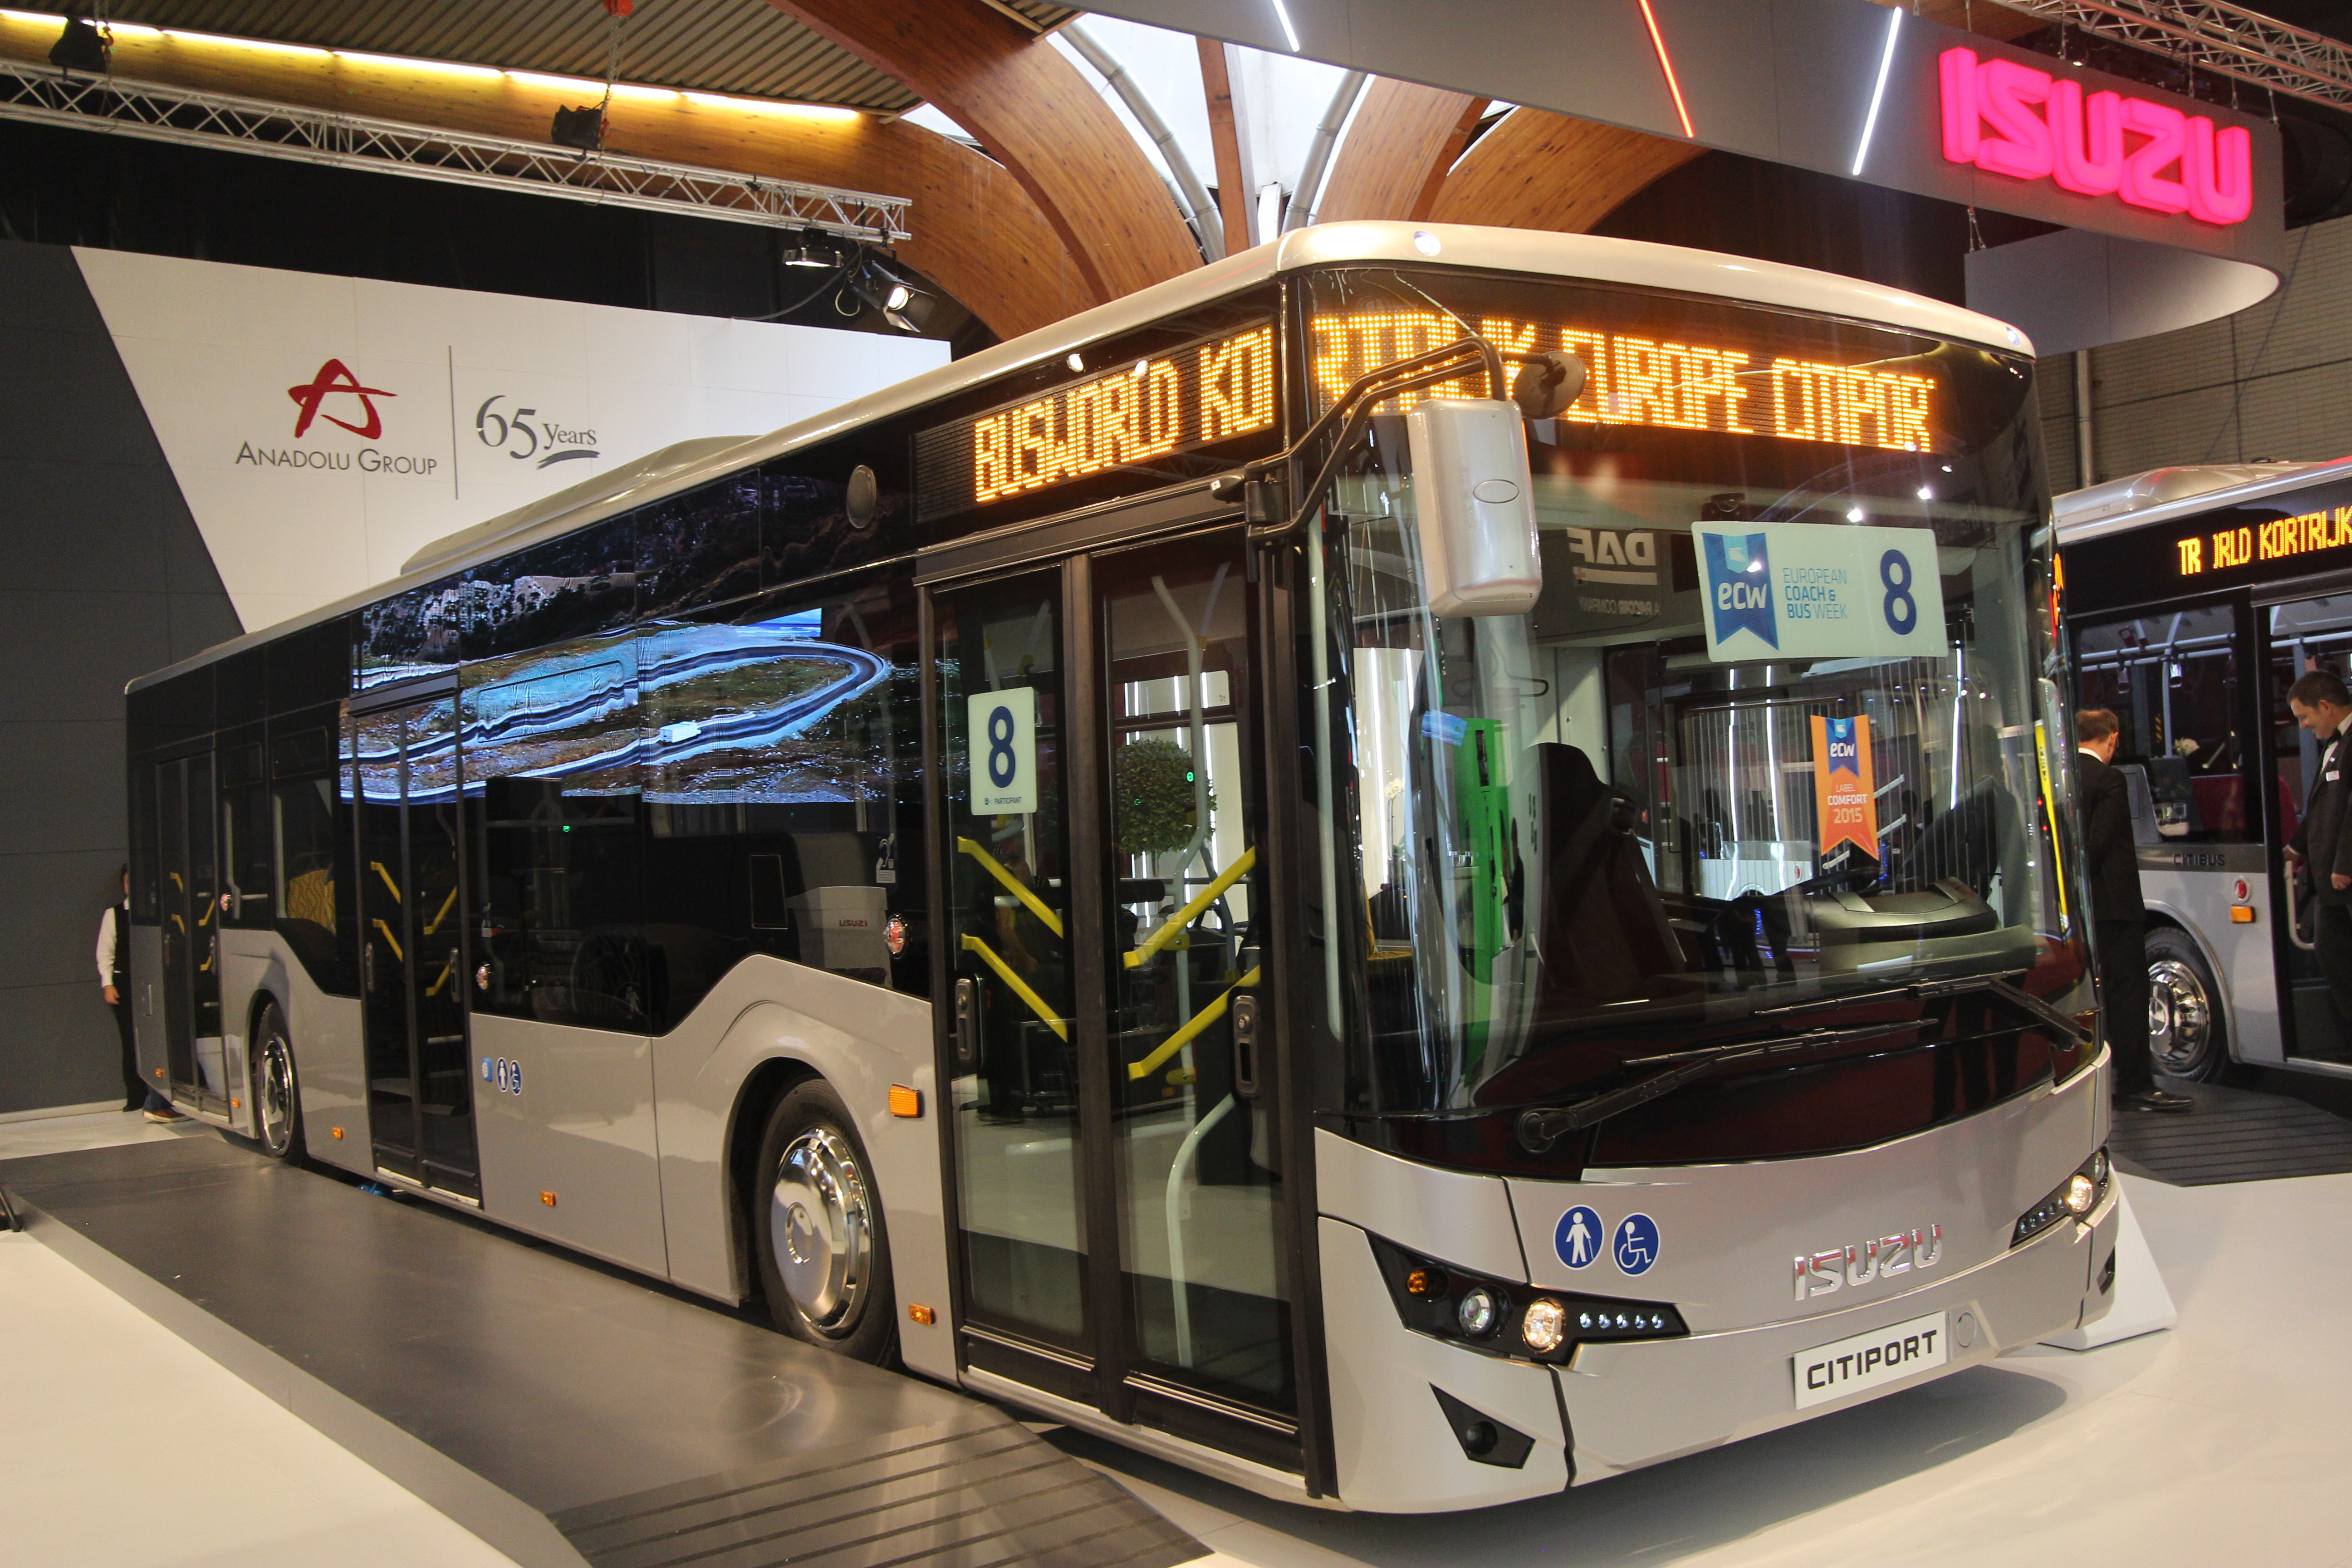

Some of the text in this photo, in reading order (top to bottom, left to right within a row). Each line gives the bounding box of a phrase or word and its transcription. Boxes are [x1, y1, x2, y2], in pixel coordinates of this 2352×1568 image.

[1938, 47, 2252, 224] ISUZU
[1562, 328, 1754, 434] EUROPE
[1771, 357, 1936, 453] CITIPOR
[476, 395, 537, 459] 65
[975, 327, 1273, 502] BUSWORLD KO
[235, 441, 437, 475] ANADOLU GROUP
[2259, 505, 2352, 561] KORTRIJK
[1783, 568, 1847, 584] EUROPEAN
[1717, 582, 1767, 611] ecw
[1785, 585, 1836, 601] COACH &
[1880, 549, 1916, 635] 8
[1787, 603, 1848, 619] BUS WEEK
[988, 706, 1016, 788] 8
[1830, 742, 1855, 758] ecw
[994, 796, 1022, 804] PARTICIPANT
[1828, 794, 1868, 806] COMFORT
[1835, 784, 1856, 793] LABEL
[1833, 807, 1863, 824] 2015
[2173, 853, 2225, 867] CITIBUS
[1793, 1224, 1942, 1301] ISUZU
[1807, 1329, 1937, 1390] CITIPORT
